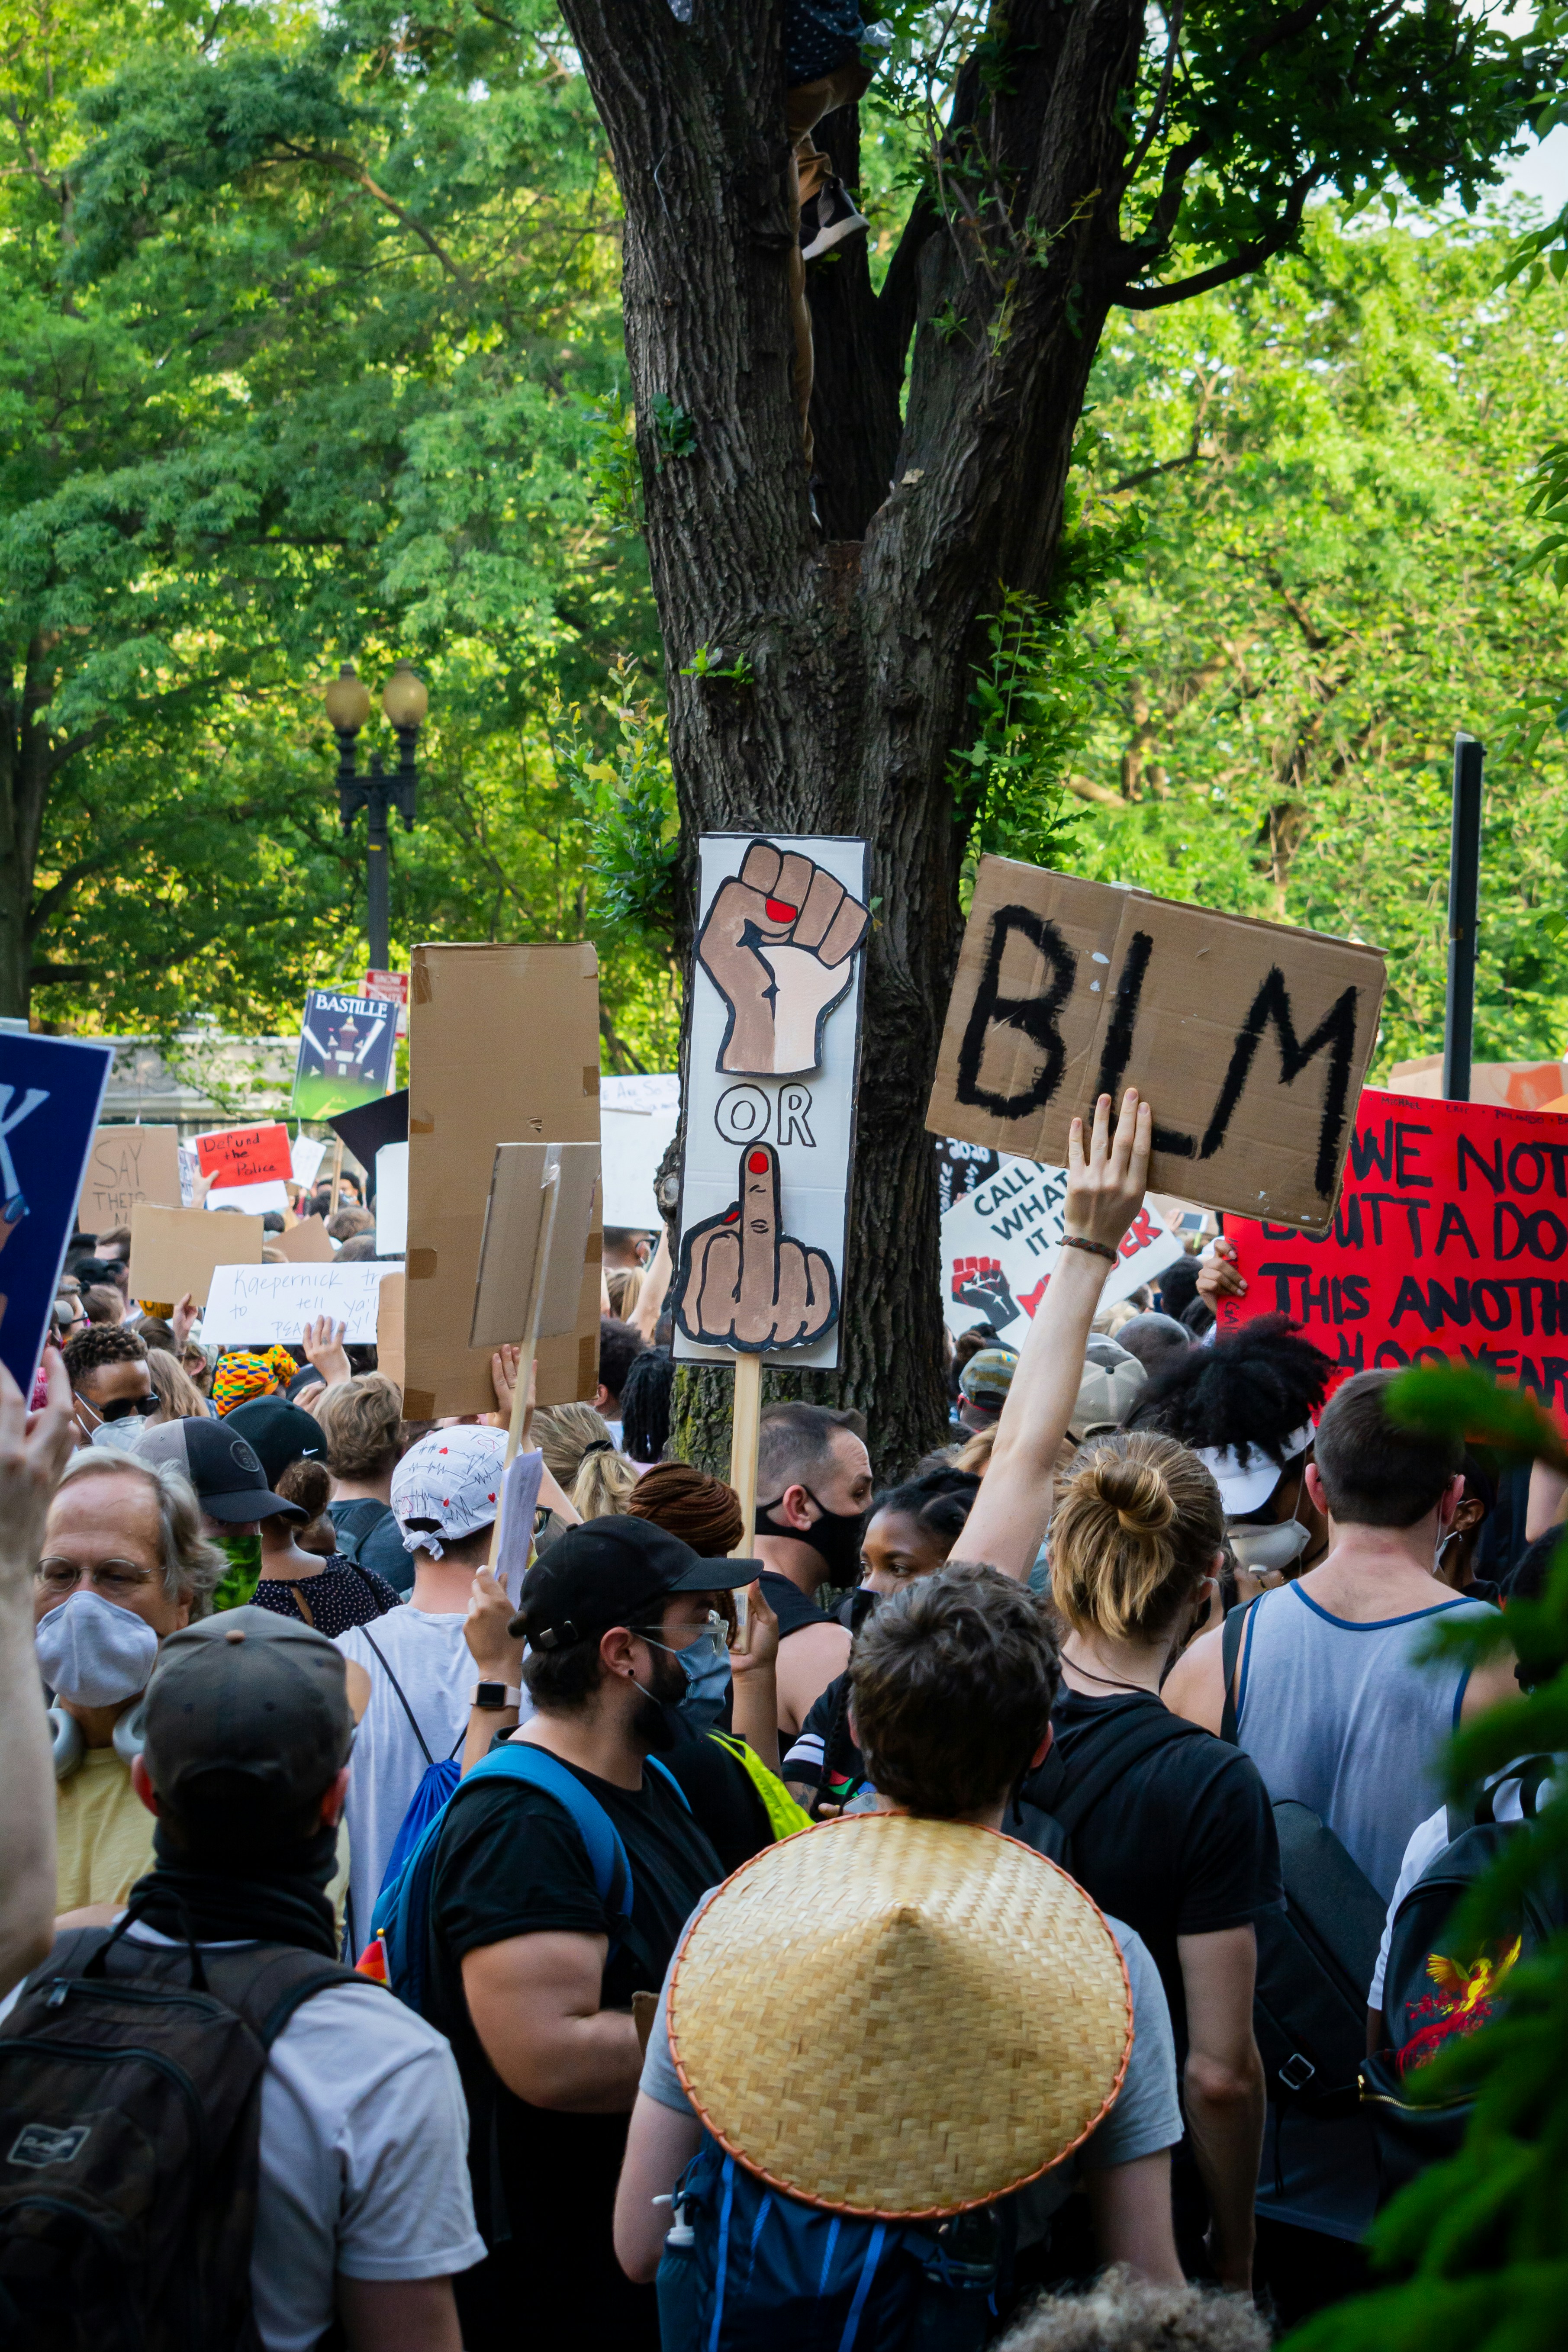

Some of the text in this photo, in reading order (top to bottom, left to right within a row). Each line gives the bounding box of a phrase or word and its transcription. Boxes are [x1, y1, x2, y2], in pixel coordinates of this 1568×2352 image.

[316, 994, 388, 1018] BASTILLE
[955, 904, 1361, 1200] BLM
[714, 1083, 817, 1147] OR
[1446, 1104, 1469, 1114] ERIC
[1494, 1109, 1544, 1124] PHILANDO
[93, 1140, 142, 1188] SAY
[203, 1133, 260, 1152] Defund
[225, 1149, 250, 1160] the
[946, 1137, 991, 1163] 2020
[1350, 1116, 1568, 1198] WE NOT
[975, 1167, 1034, 1216] CALL
[990, 1171, 1068, 1240] WHAT
[1025, 1209, 1065, 1256] IT I
[1261, 1192, 1480, 1258] UTTA
[1493, 1201, 1568, 1261] DO
[234, 1269, 343, 1299] Kaepernick
[1257, 1262, 1568, 1337] THIS ANOTH
[229, 1304, 248, 1319] to
[296, 1297, 323, 1309] tell
